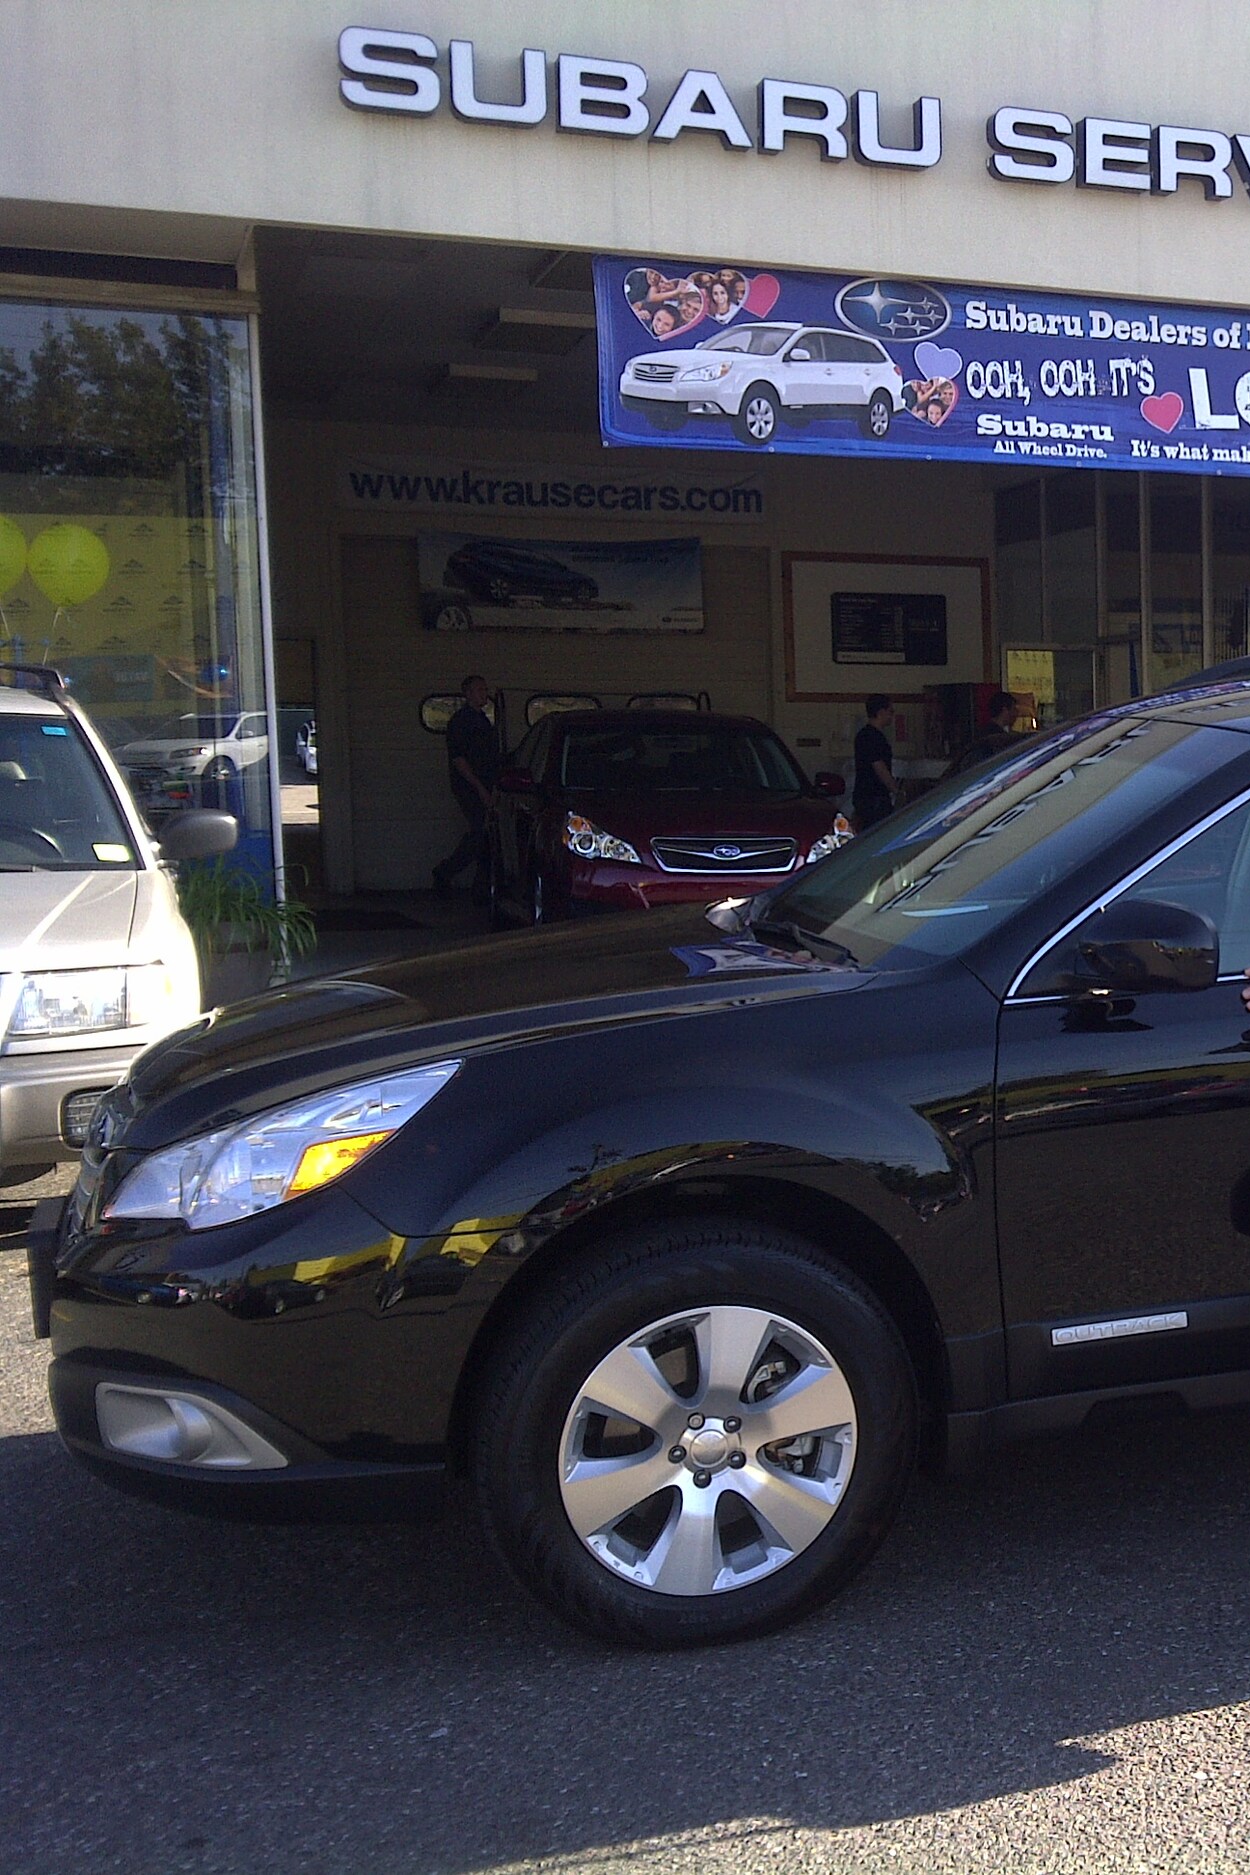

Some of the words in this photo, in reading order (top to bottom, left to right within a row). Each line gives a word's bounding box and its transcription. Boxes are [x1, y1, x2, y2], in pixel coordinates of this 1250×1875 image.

[338, 25, 943, 171] SUBARU
[965, 300, 1084, 338] Subaru
[1089, 310, 1207, 347] Dealers
[1212, 322, 1242, 350] of
[966, 360, 1031, 406] OOH,
[1040, 359, 1096, 397] OOH
[1109, 356, 1156, 396] IT'S
[977, 413, 1114, 441] Subaru
[993, 440, 1015, 454] All
[1017, 441, 1062, 456] Wheel
[1064, 444, 1108, 459] Drive.
[1131, 439, 1160, 459] It's
[1162, 443, 1209, 461] what
[349, 470, 763, 514] www.krausecars.com
